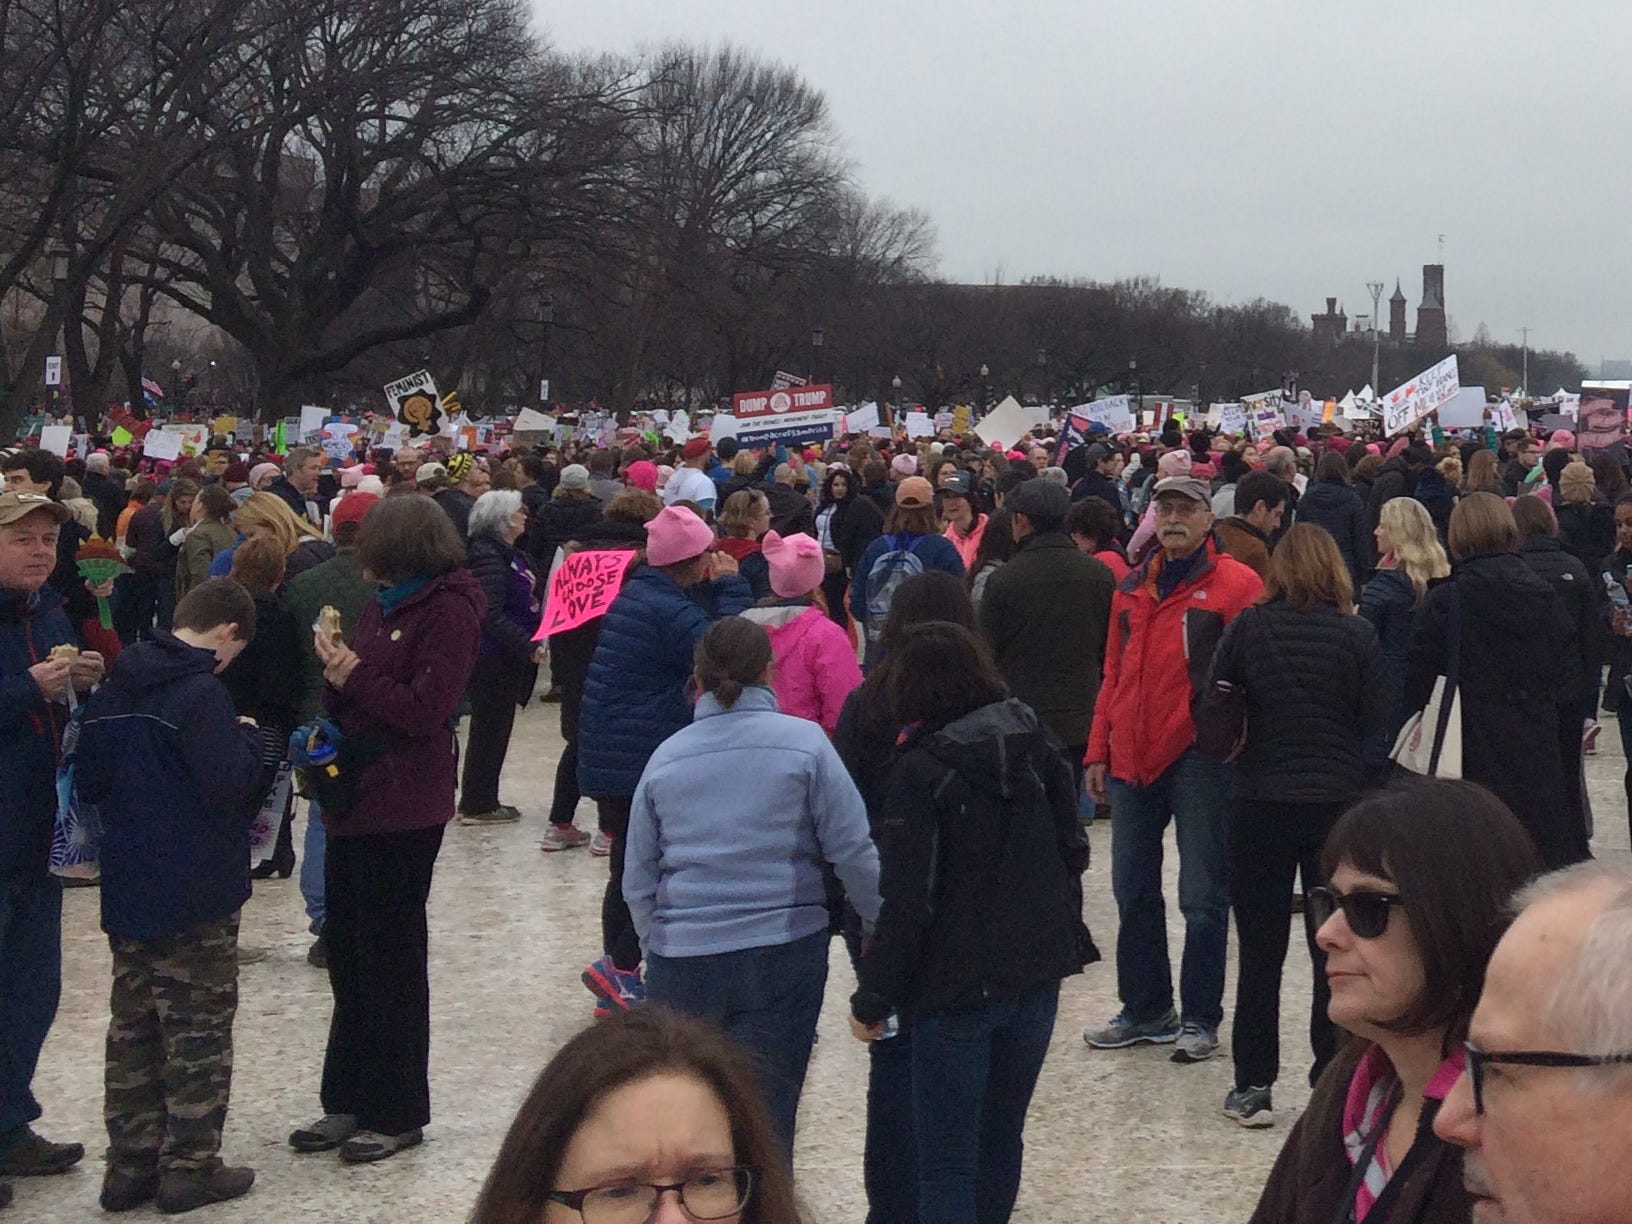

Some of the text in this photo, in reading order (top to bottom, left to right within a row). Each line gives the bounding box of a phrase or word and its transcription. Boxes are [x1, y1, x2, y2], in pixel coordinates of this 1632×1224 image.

[385, 371, 430, 398] FEMINIST
[739, 390, 827, 413] DUMP TRUMP
[1387, 405, 1410, 430] OFF
[554, 553, 624, 597] ALWAYS
[562, 569, 618, 604] CHOOSE
[551, 590, 606, 628] LOVE
